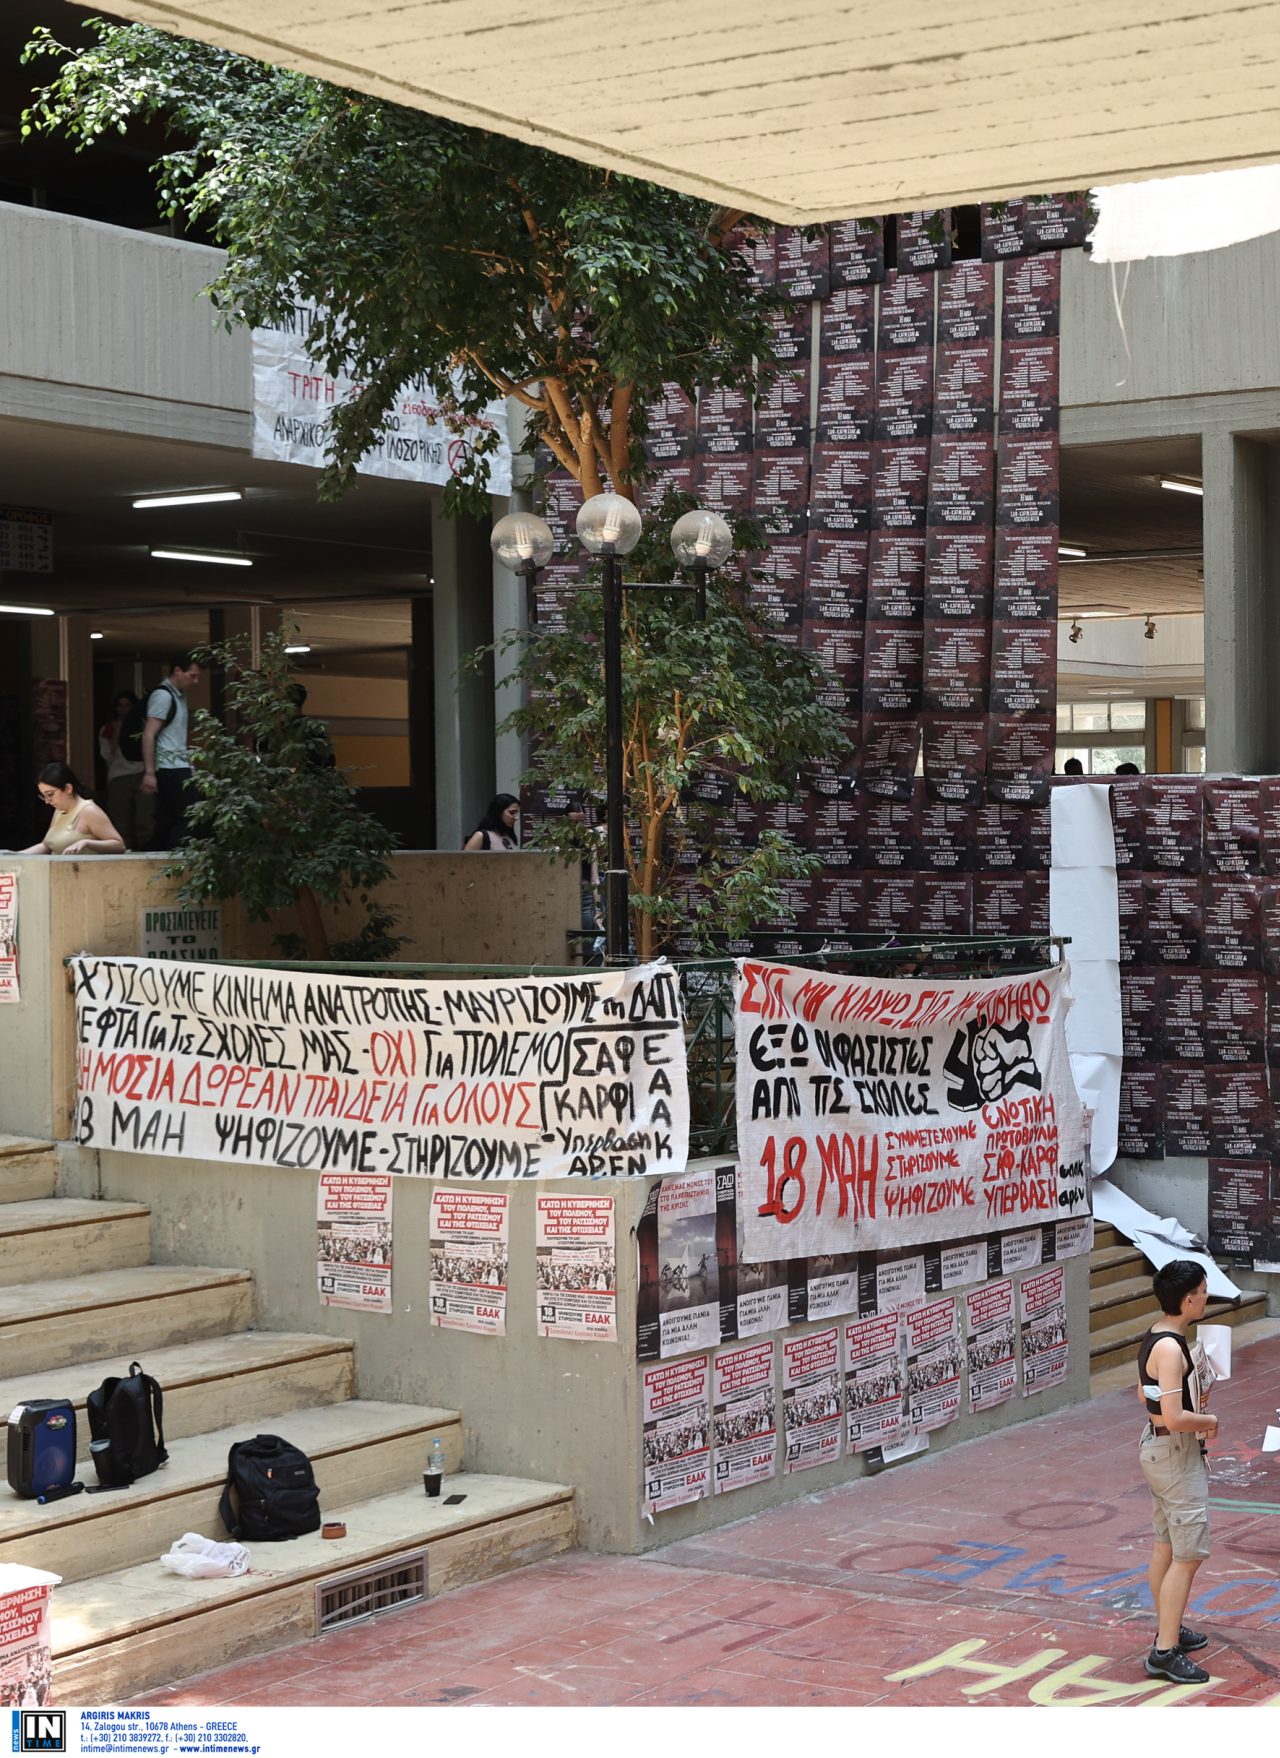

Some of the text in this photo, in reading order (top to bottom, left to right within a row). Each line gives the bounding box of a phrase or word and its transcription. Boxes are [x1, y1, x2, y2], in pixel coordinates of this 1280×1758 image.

[288, 371, 335, 402] ΤΡΙΤΗ
[145, 911, 219, 932] ΠΡΟΣΤΑΤΕΥΕΤΕ
[166, 935, 196, 944] ΤΟ
[77, 961, 206, 1016] ΧΤΙΖΟΥΜΕ
[213, 972, 300, 1024] ΚΙΝΗΜΑ
[629, 972, 679, 1021] ΔΑΠ
[198, 1016, 297, 1070] ΣΧΟΛΕΣ
[300, 1029, 359, 1074] ΜΑΣ
[454, 1031, 563, 1078] ΠΟΛΕΜΟ
[573, 1034, 635, 1076] ΣΑΦ
[750, 1023, 809, 1071] ΕΞΩ
[833, 1032, 933, 1077] ΦΑΣΙΣΤΕΣ
[180, 1061, 301, 1117] ΔΩΡΕΑΝ
[304, 1074, 405, 1124] ΠΑΙΔΕΙΑ
[444, 1081, 540, 1129] ΟΛΟΥΣ
[554, 1081, 636, 1124] ΚΑΡΦΙ
[853, 1079, 939, 1117] ΣΧΟΛΕΣ
[76, 1096, 95, 1145] 8
[112, 1104, 185, 1153] ΜΑΗ
[757, 1133, 879, 1224] 18 ΜΑΗ
[984, 1177, 1058, 1219] ΥΠΕΡΒΑΣΗ
[362, 1285, 386, 1297] ΕΑΑΚ
[476, 1306, 500, 1319] ΕΑΑΚ
[585, 1313, 611, 1325] ΕΑΑΚ
